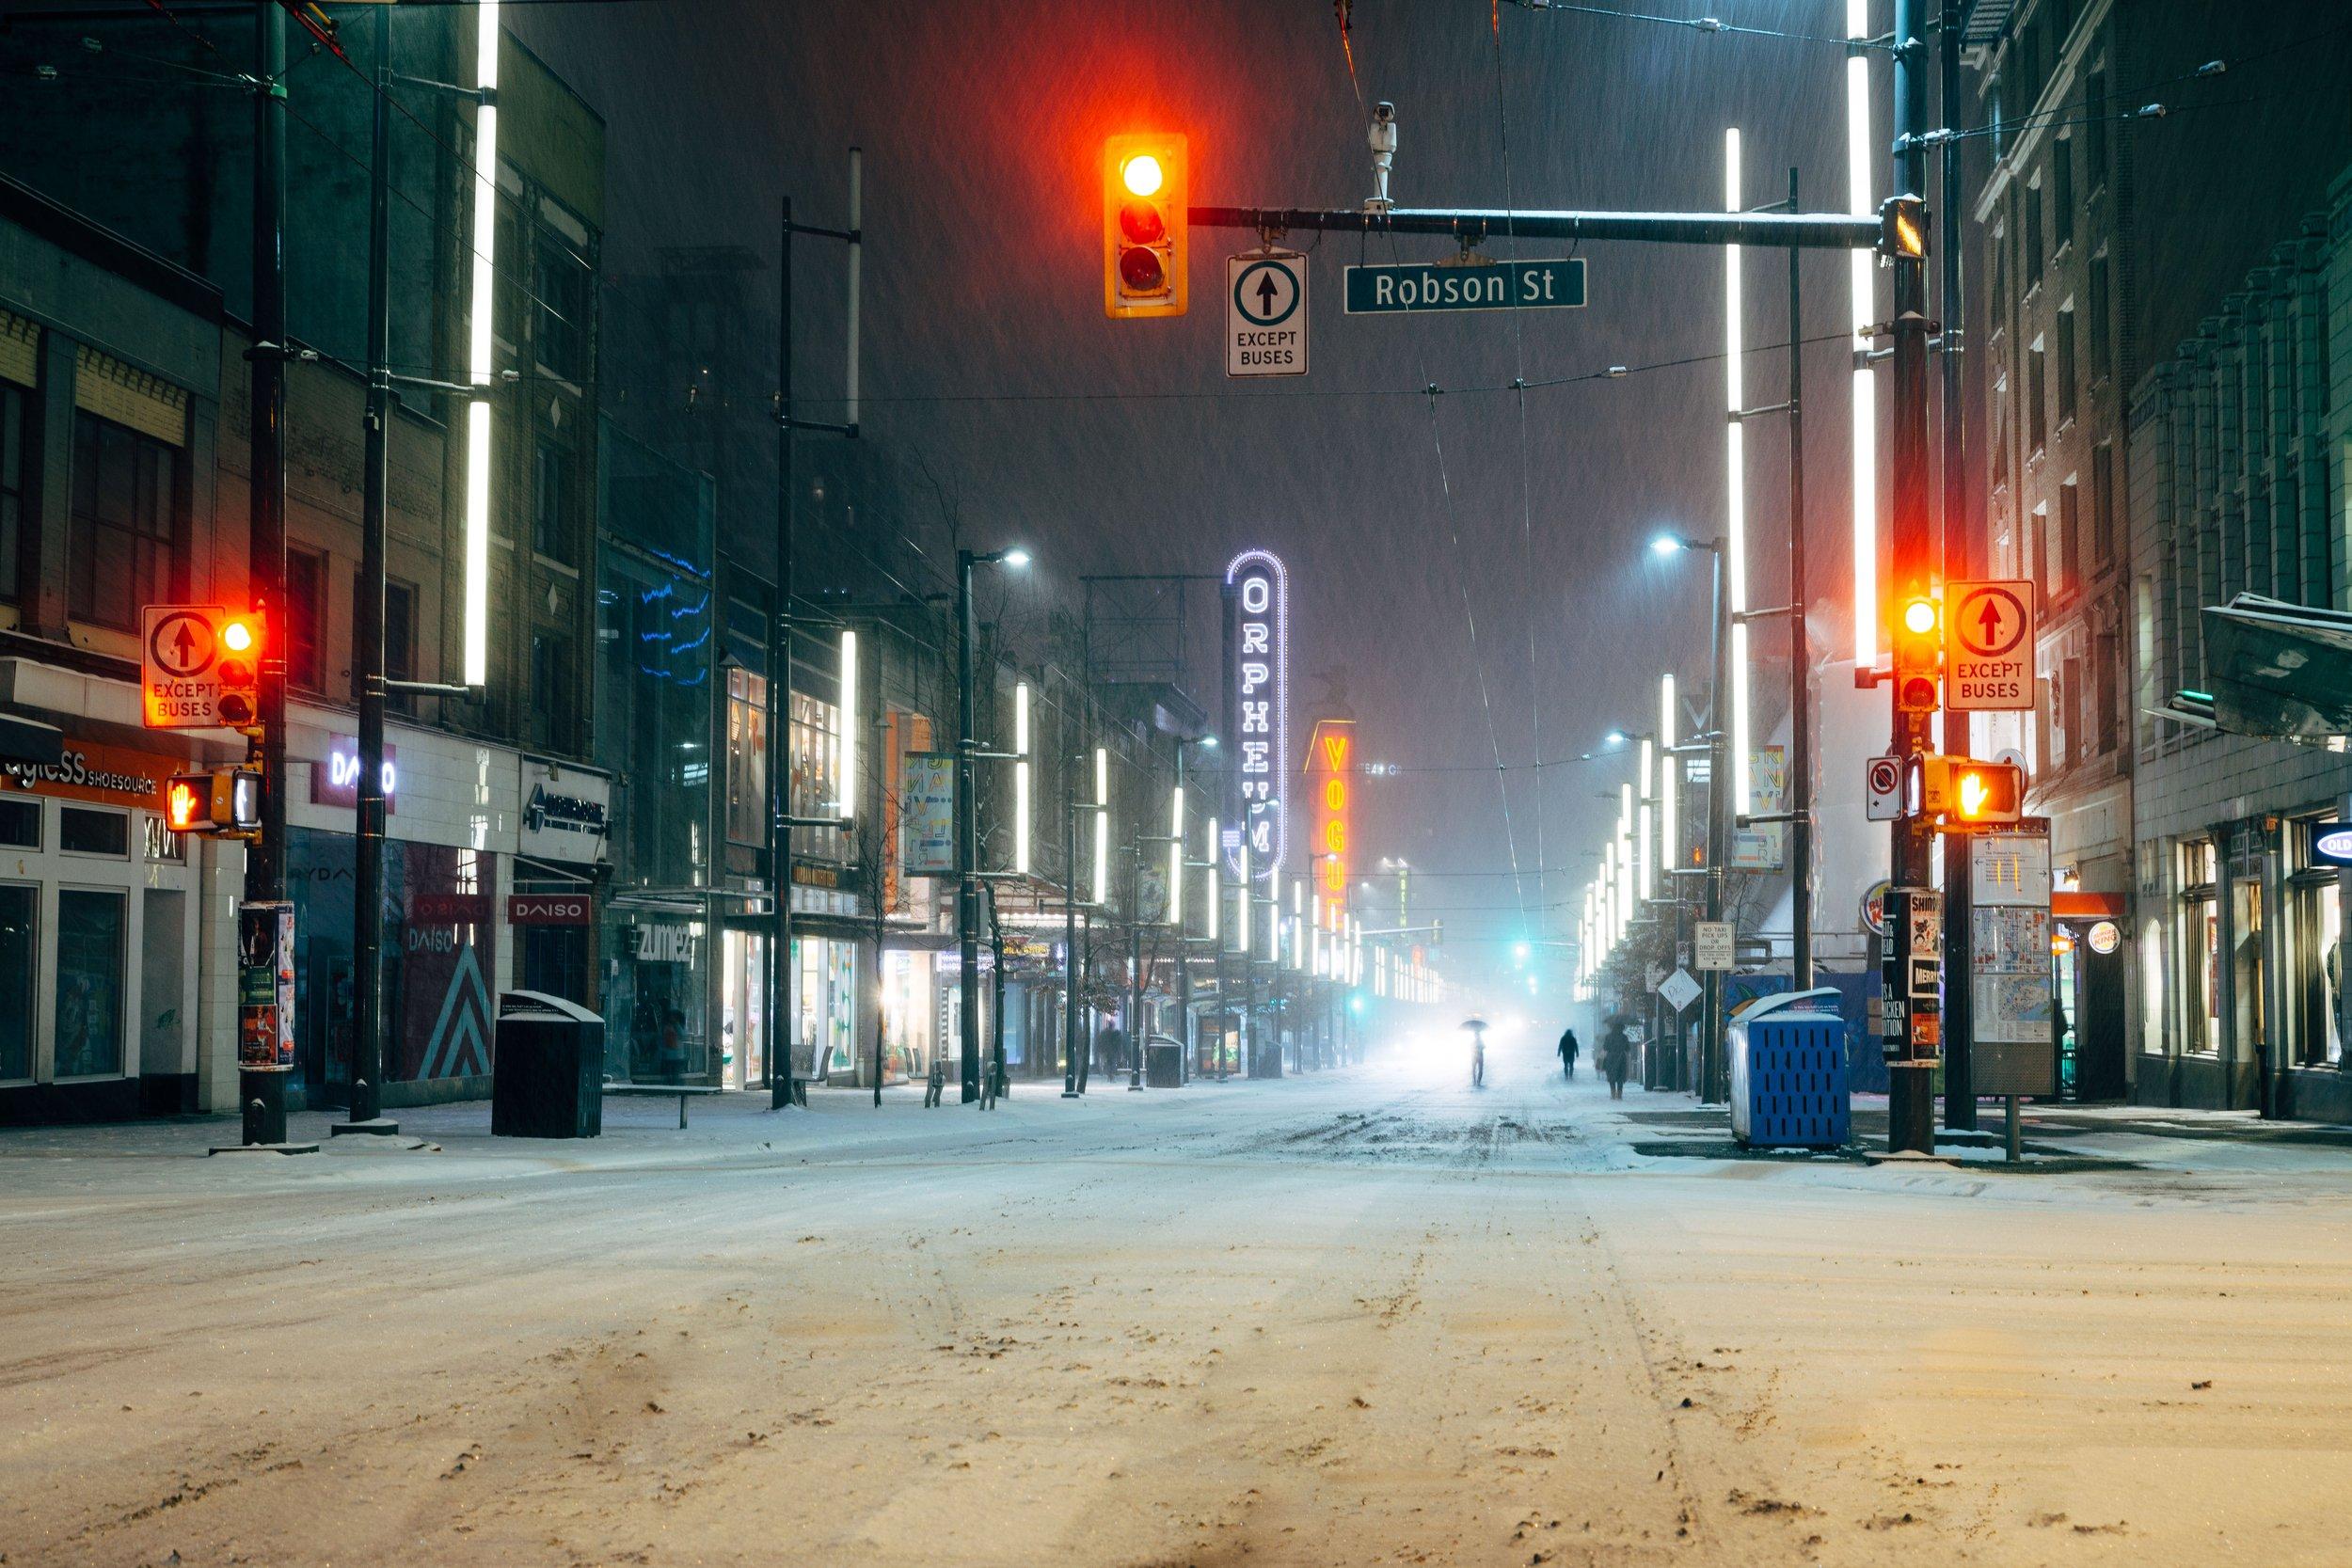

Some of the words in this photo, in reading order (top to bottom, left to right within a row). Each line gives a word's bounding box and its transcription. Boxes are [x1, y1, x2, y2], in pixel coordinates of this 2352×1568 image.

[1375, 272, 1504, 305] Robson
[1523, 269, 1554, 301] St
[1237, 331, 1296, 347] EXCEPT
[1241, 350, 1294, 366] BUSES
[1958, 662, 2023, 678] EXCEPT
[153, 683, 215, 697] EXCEPT
[1962, 683, 2019, 698] BUSES
[158, 703, 212, 717] BUSES
[332, 752, 395, 794] DAO
[1324, 737, 1346, 929] VOGUE
[2328, 839, 2352, 851] OLD
[516, 904, 582, 917] DAISO
[408, 927, 453, 954] DAISO
[2094, 933, 2118, 945] KING
